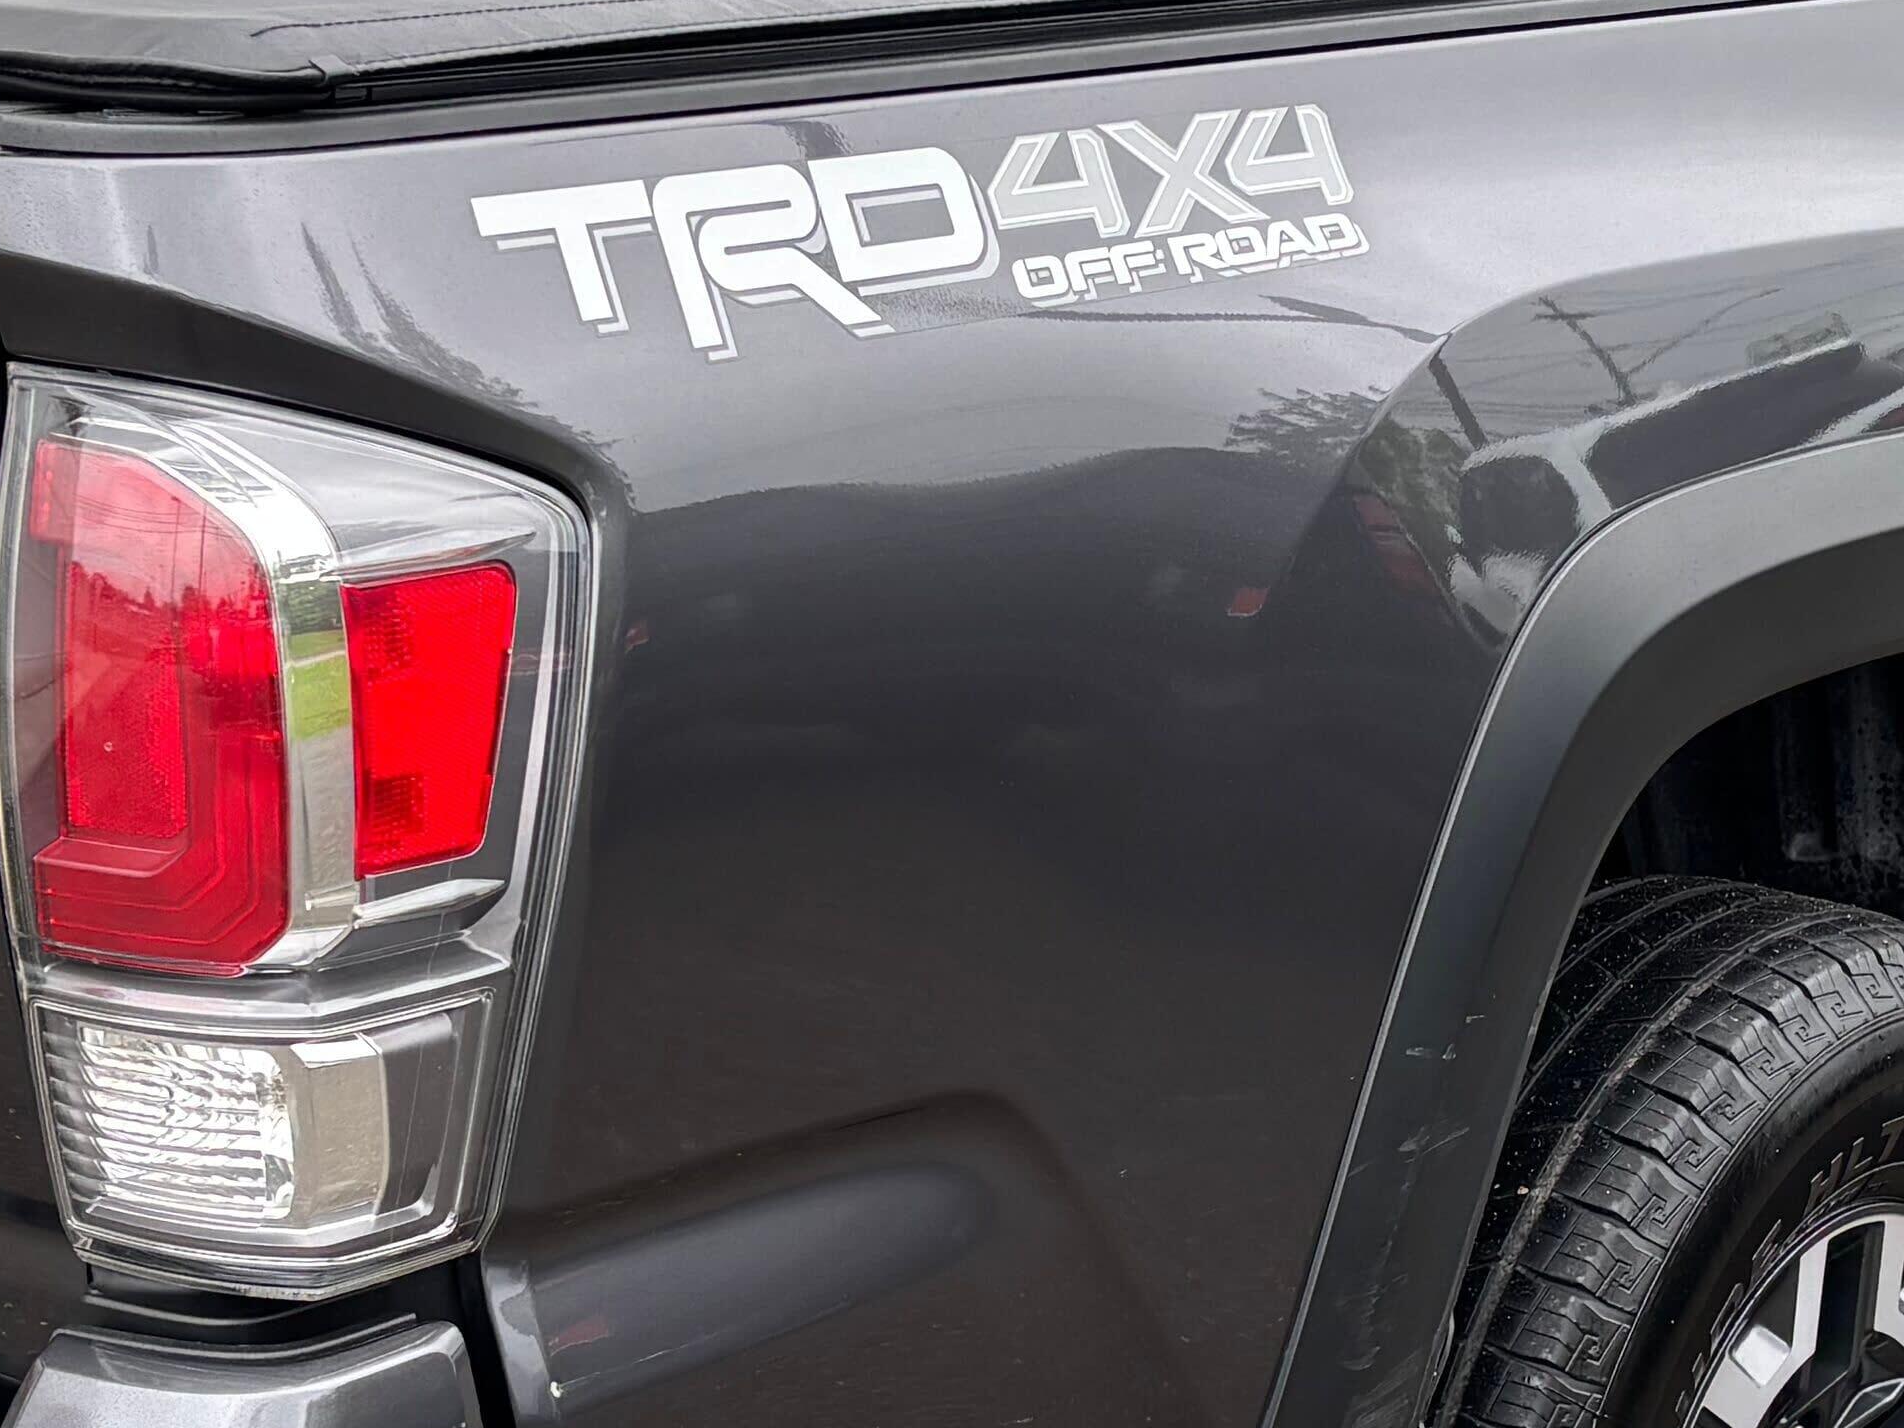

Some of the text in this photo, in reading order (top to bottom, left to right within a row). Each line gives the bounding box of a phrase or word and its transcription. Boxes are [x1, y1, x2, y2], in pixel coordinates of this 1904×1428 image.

[469, 103, 1355, 364] TRD 4X4
[1011, 212, 1371, 308] OFF ROAD
